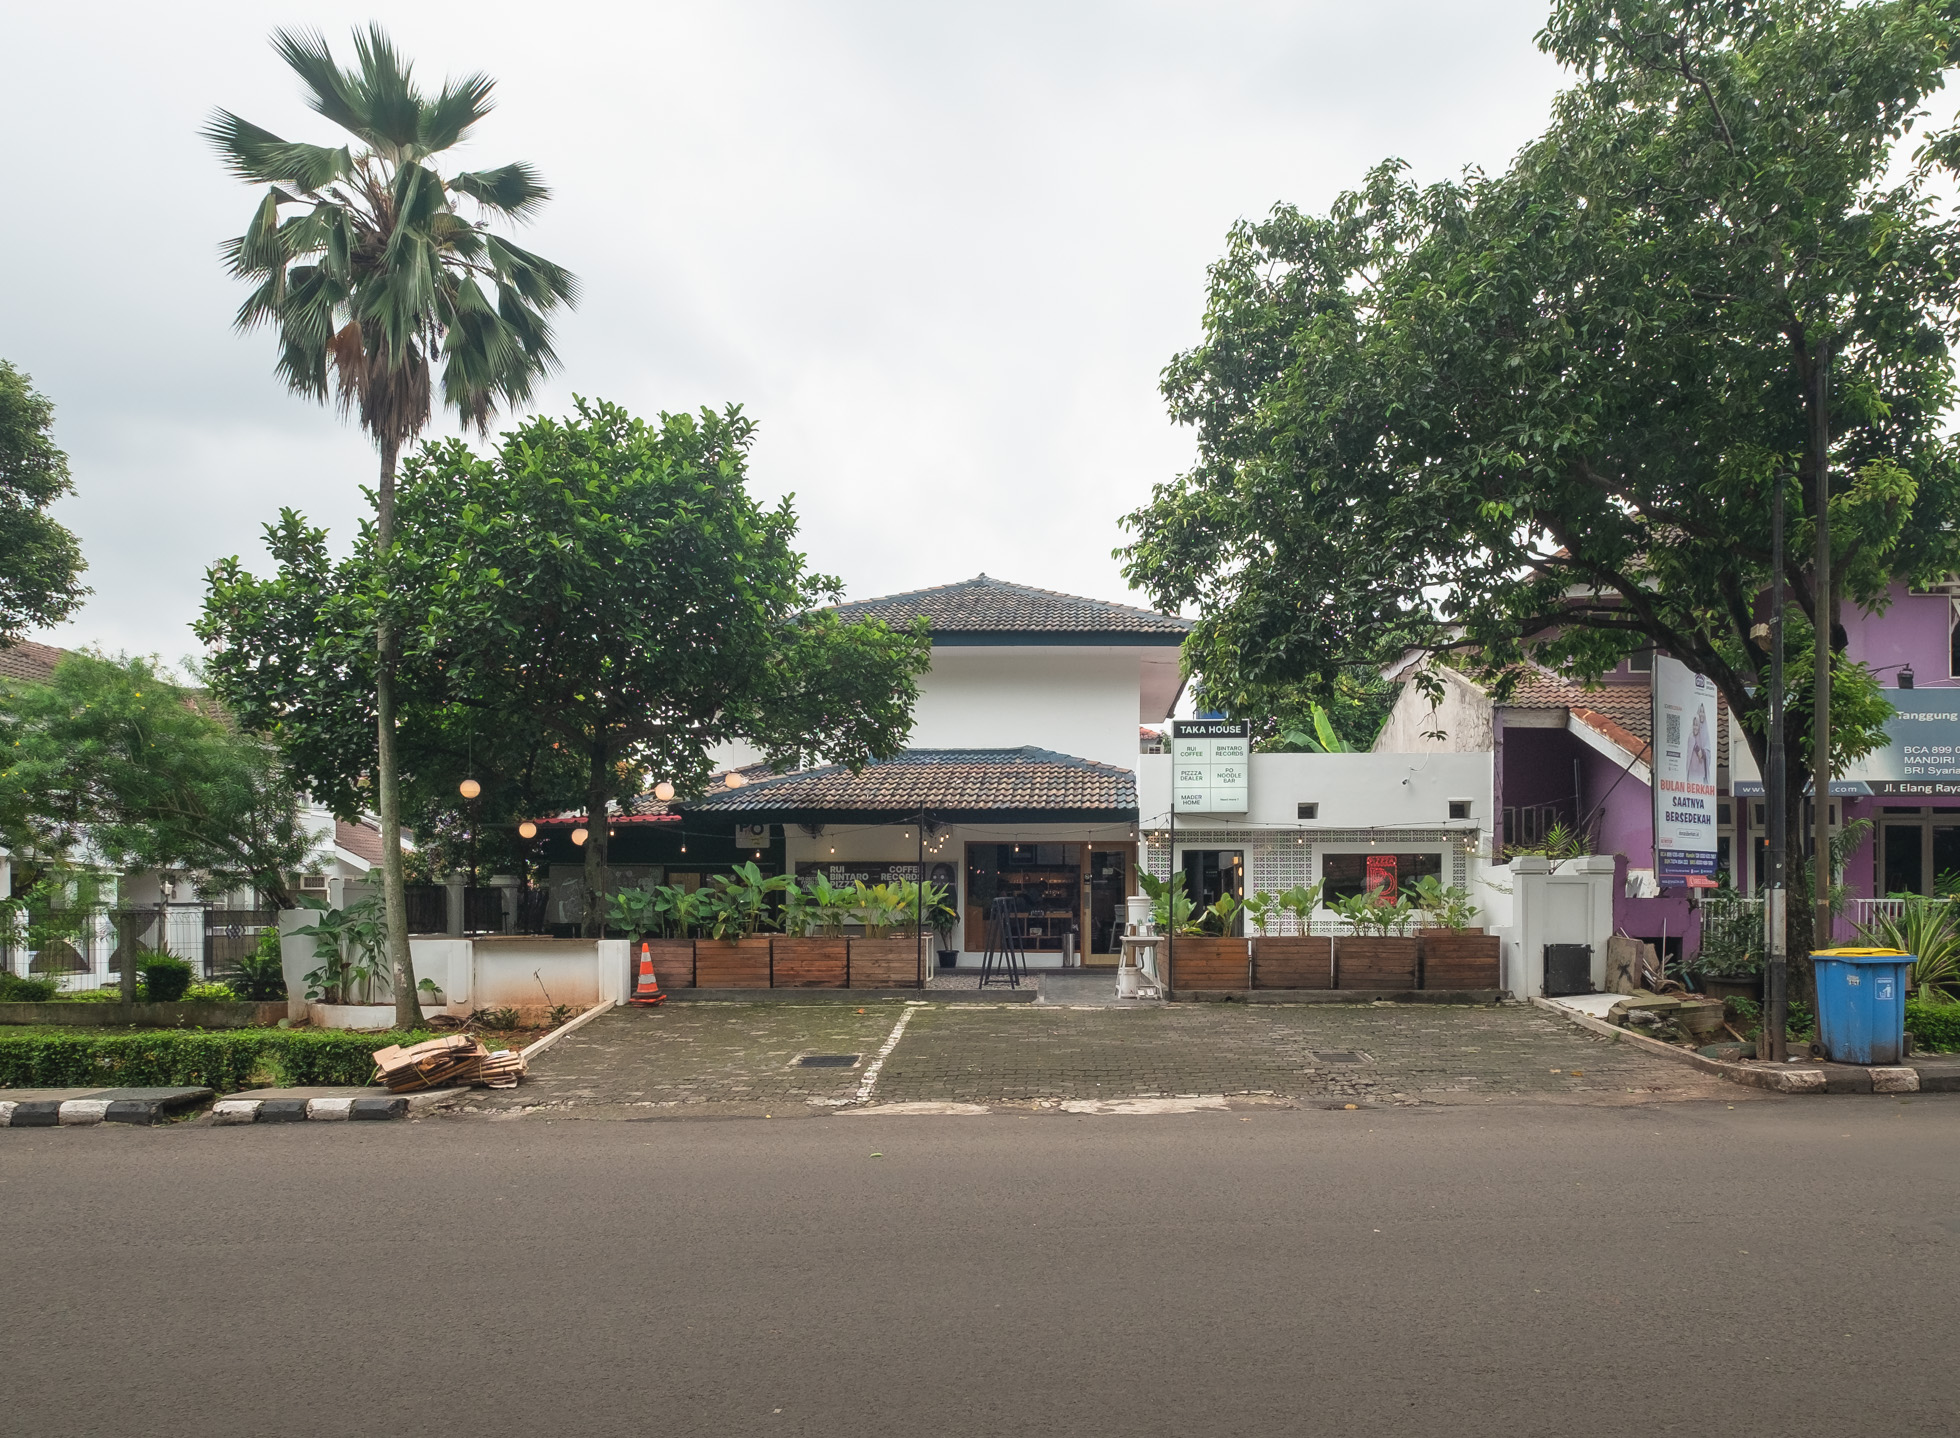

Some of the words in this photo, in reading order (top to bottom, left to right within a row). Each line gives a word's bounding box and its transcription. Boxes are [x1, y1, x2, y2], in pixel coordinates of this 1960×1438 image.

[1896, 711, 1958, 722] Tanggung
[1180, 725, 1206, 734] TAKA
[1208, 725, 1241, 734] HOUSE
[1903, 746, 1929, 754] BCA
[1931, 746, 1952, 754] 899
[1904, 756, 1955, 764] MANDIRI
[1904, 766, 1924, 775] BRI
[1660, 779, 1685, 793] BULAN
[1686, 782, 1715, 796] BERKAH
[1883, 783, 1896, 793] Jl.
[1900, 783, 1933, 794] Elang
[1672, 796, 1705, 809] SAATNYA
[1665, 811, 1711, 825] BERSEDEKAH
[829, 865, 845, 873] RUI
[829, 873, 869, 881] BINTARO
